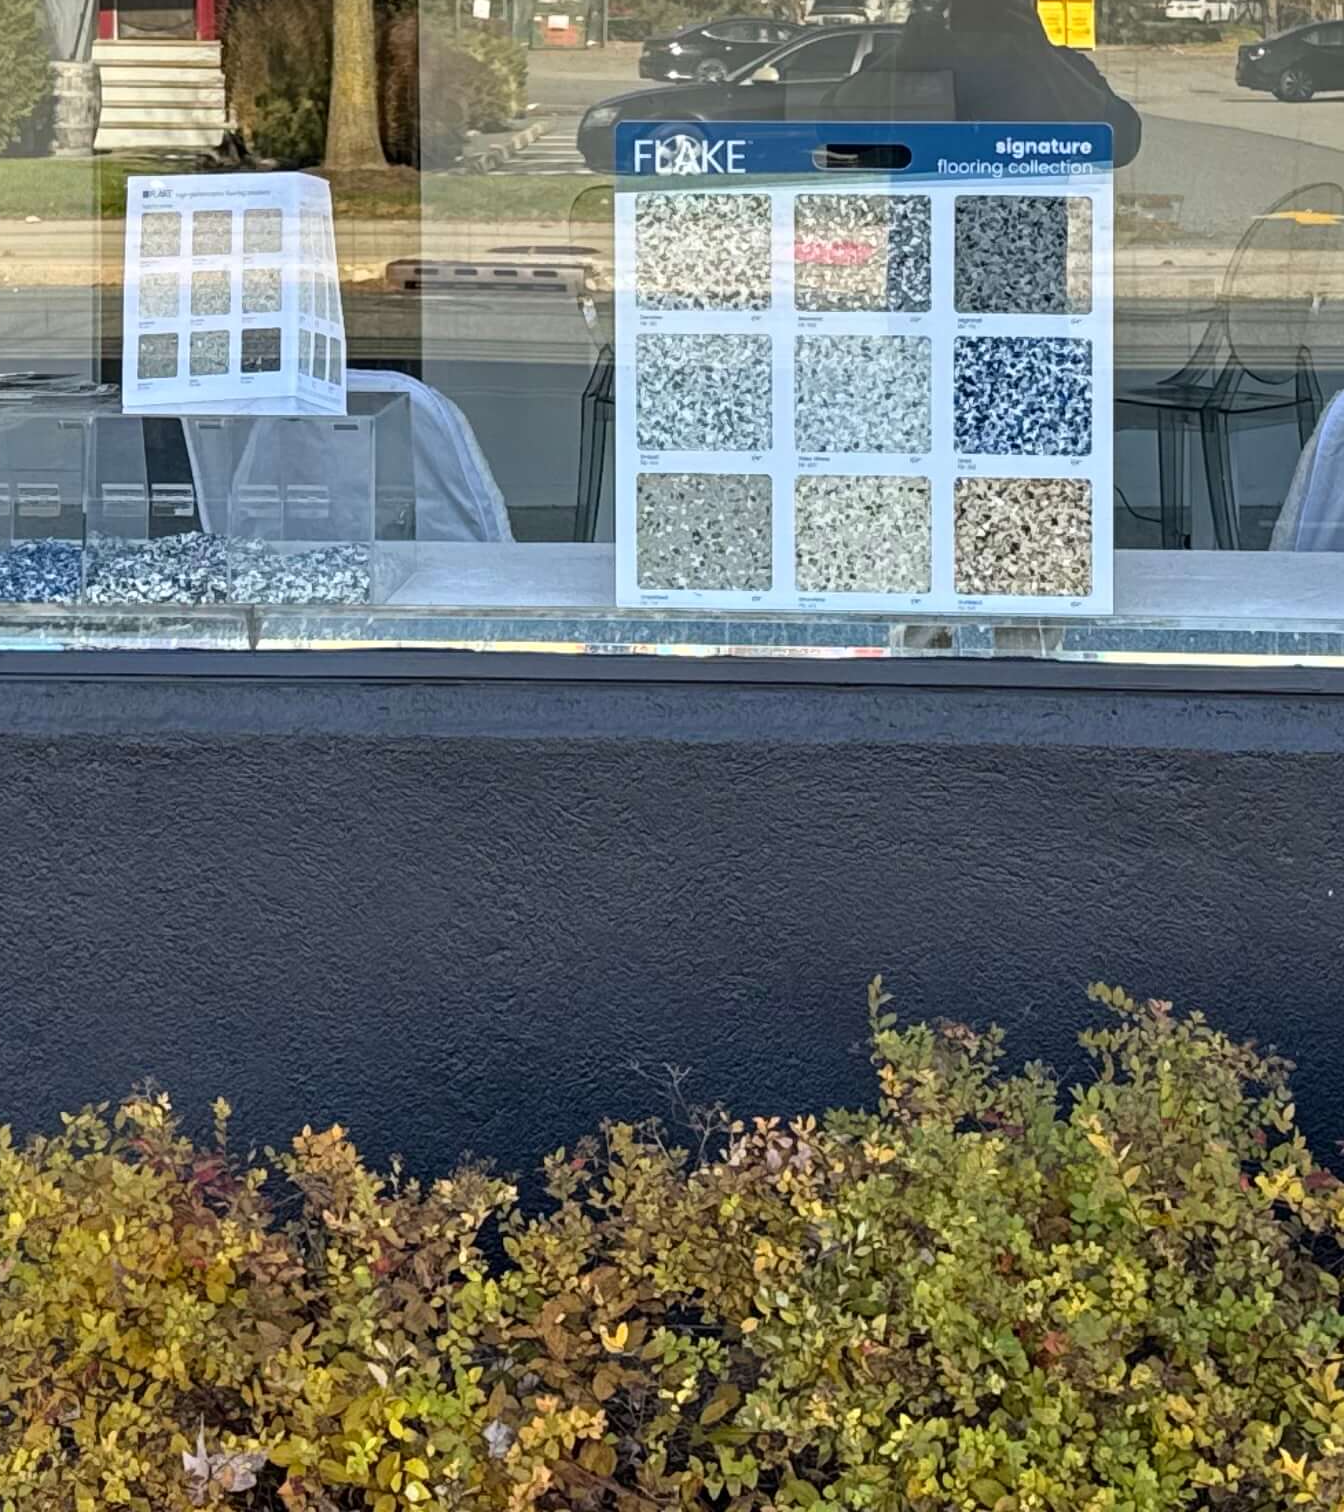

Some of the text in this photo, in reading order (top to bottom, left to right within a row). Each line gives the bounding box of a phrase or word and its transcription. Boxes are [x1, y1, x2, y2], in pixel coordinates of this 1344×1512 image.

[634, 139, 747, 175] FLAKE
[995, 137, 1093, 159] signature
[937, 158, 1094, 178] flooring collection
